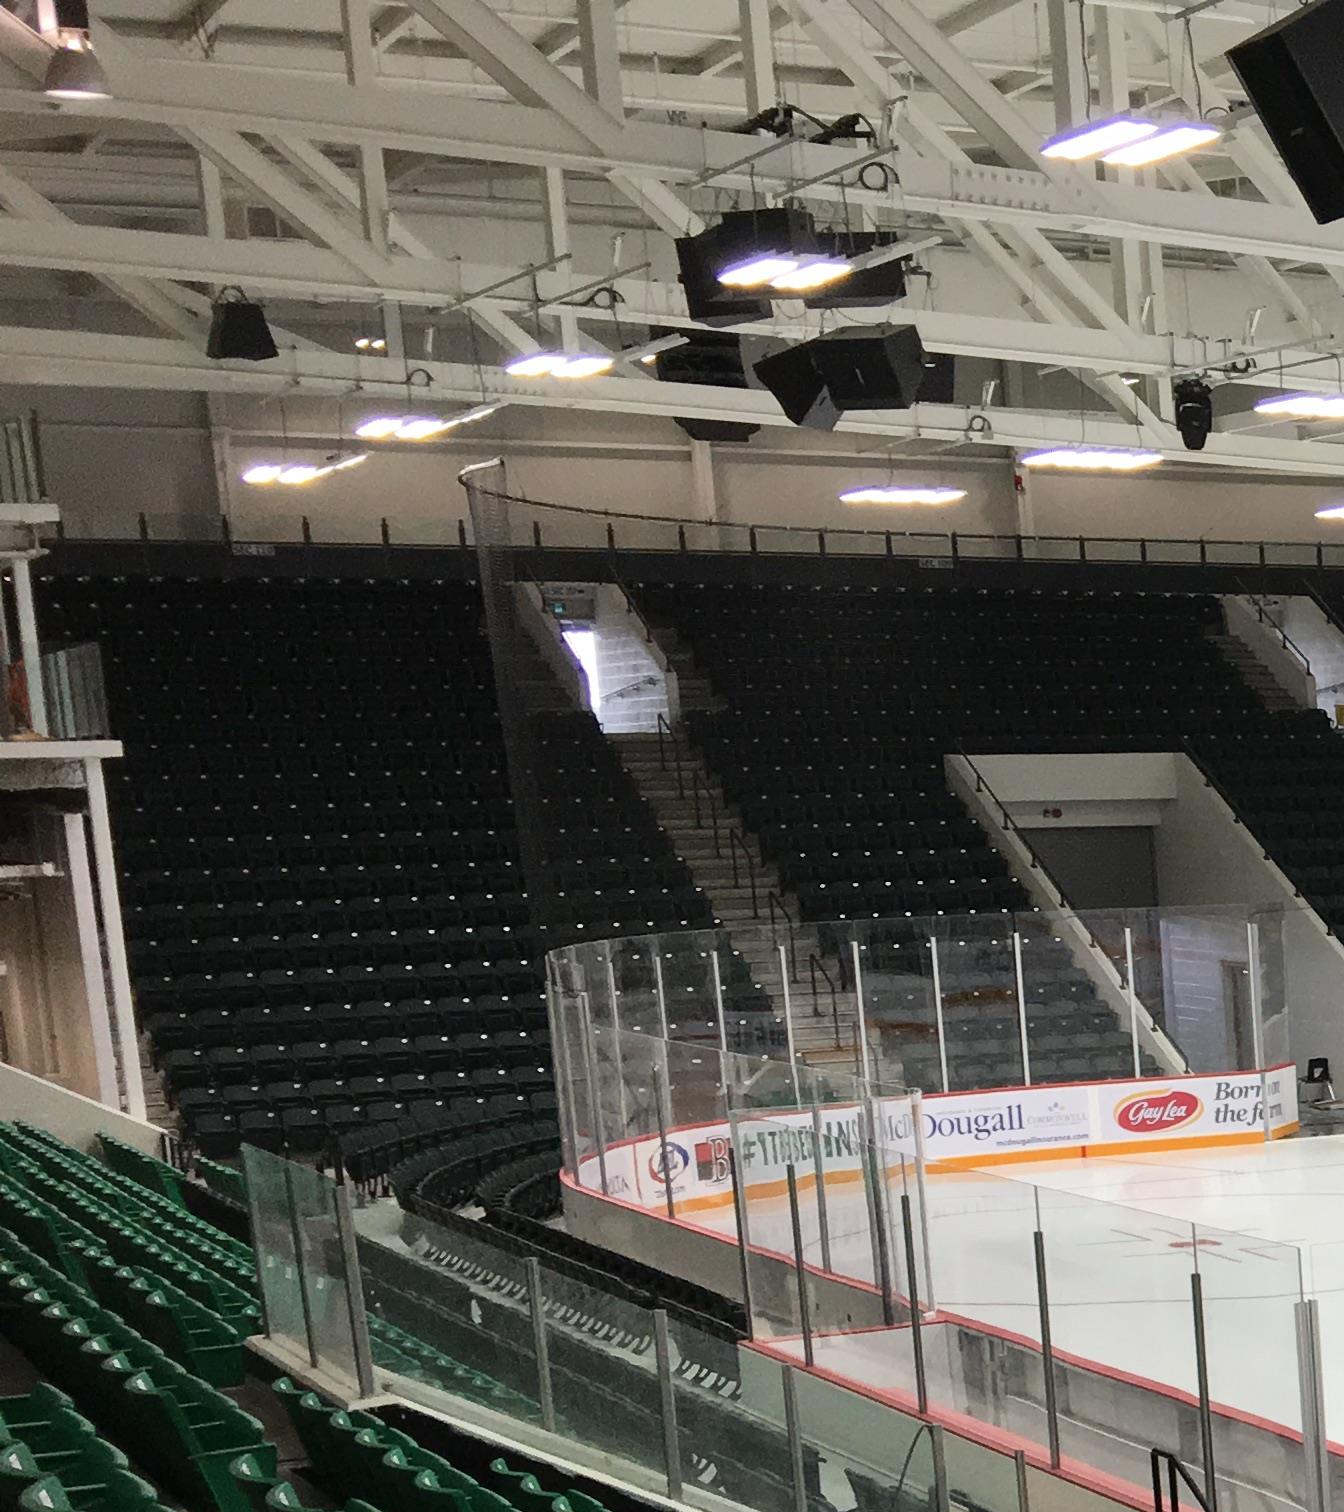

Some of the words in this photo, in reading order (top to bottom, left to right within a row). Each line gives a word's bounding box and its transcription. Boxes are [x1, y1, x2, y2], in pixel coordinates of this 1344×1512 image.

[1128, 1101, 1161, 1125] Gay
[1161, 1099, 1188, 1122] Lea
[1215, 1103, 1248, 1124] the
